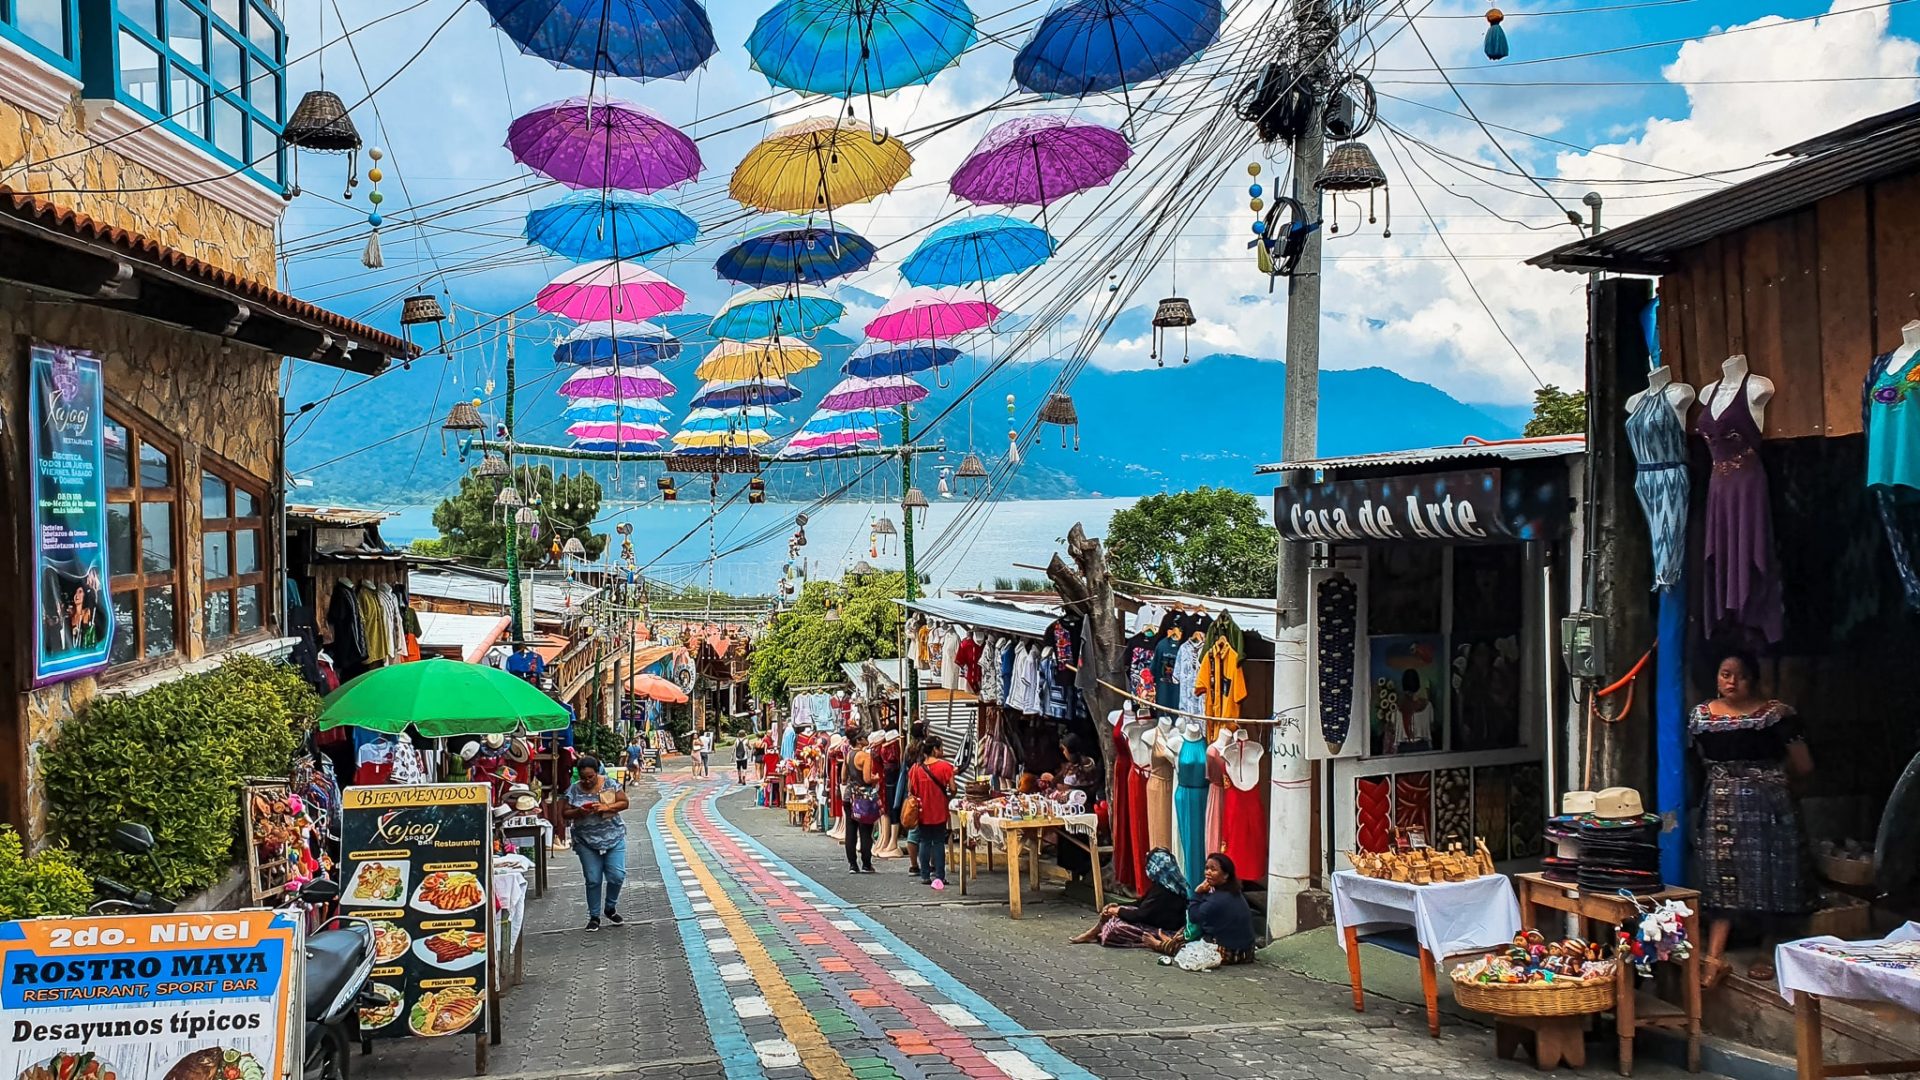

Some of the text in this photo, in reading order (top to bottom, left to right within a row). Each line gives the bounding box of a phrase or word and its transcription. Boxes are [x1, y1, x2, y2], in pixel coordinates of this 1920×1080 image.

[1290, 494, 1487, 541] Casa de Arte
[356, 786, 477, 806] BIENVENIDOS
[404, 834, 429, 842] SPORT
[434, 839, 481, 848] Restaurante
[50, 920, 250, 948] 2do. Nivel
[12, 952, 268, 985] ROSTRO MAYA
[23, 979, 258, 1001] RESTAURANT, SPORT BAR
[12, 1010, 261, 1045] Desayunos típicos
